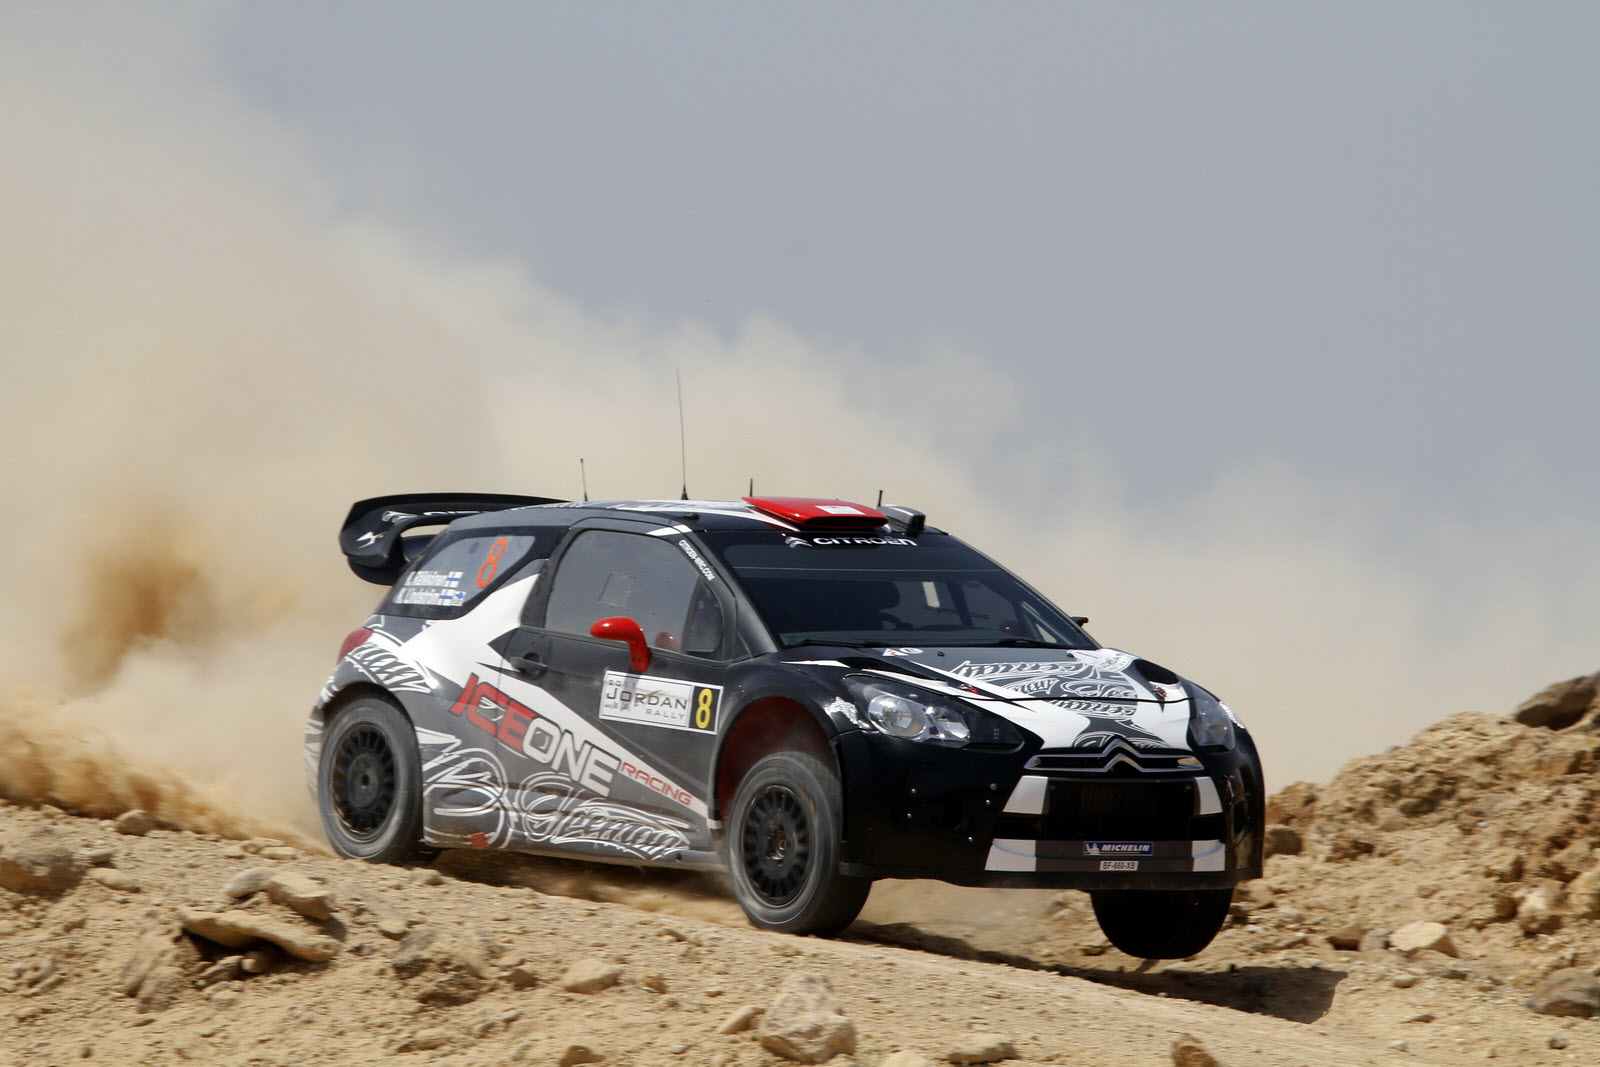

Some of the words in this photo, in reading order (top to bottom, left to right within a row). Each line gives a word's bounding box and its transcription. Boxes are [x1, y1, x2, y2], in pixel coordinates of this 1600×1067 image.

[476, 537, 508, 588] 8
[606, 688, 687, 710] JORDAN
[645, 708, 686, 719] RALLY
[696, 688, 713, 728] 8
[620, 762, 692, 806] RACING
[1101, 844, 1150, 852] MICHELIN
